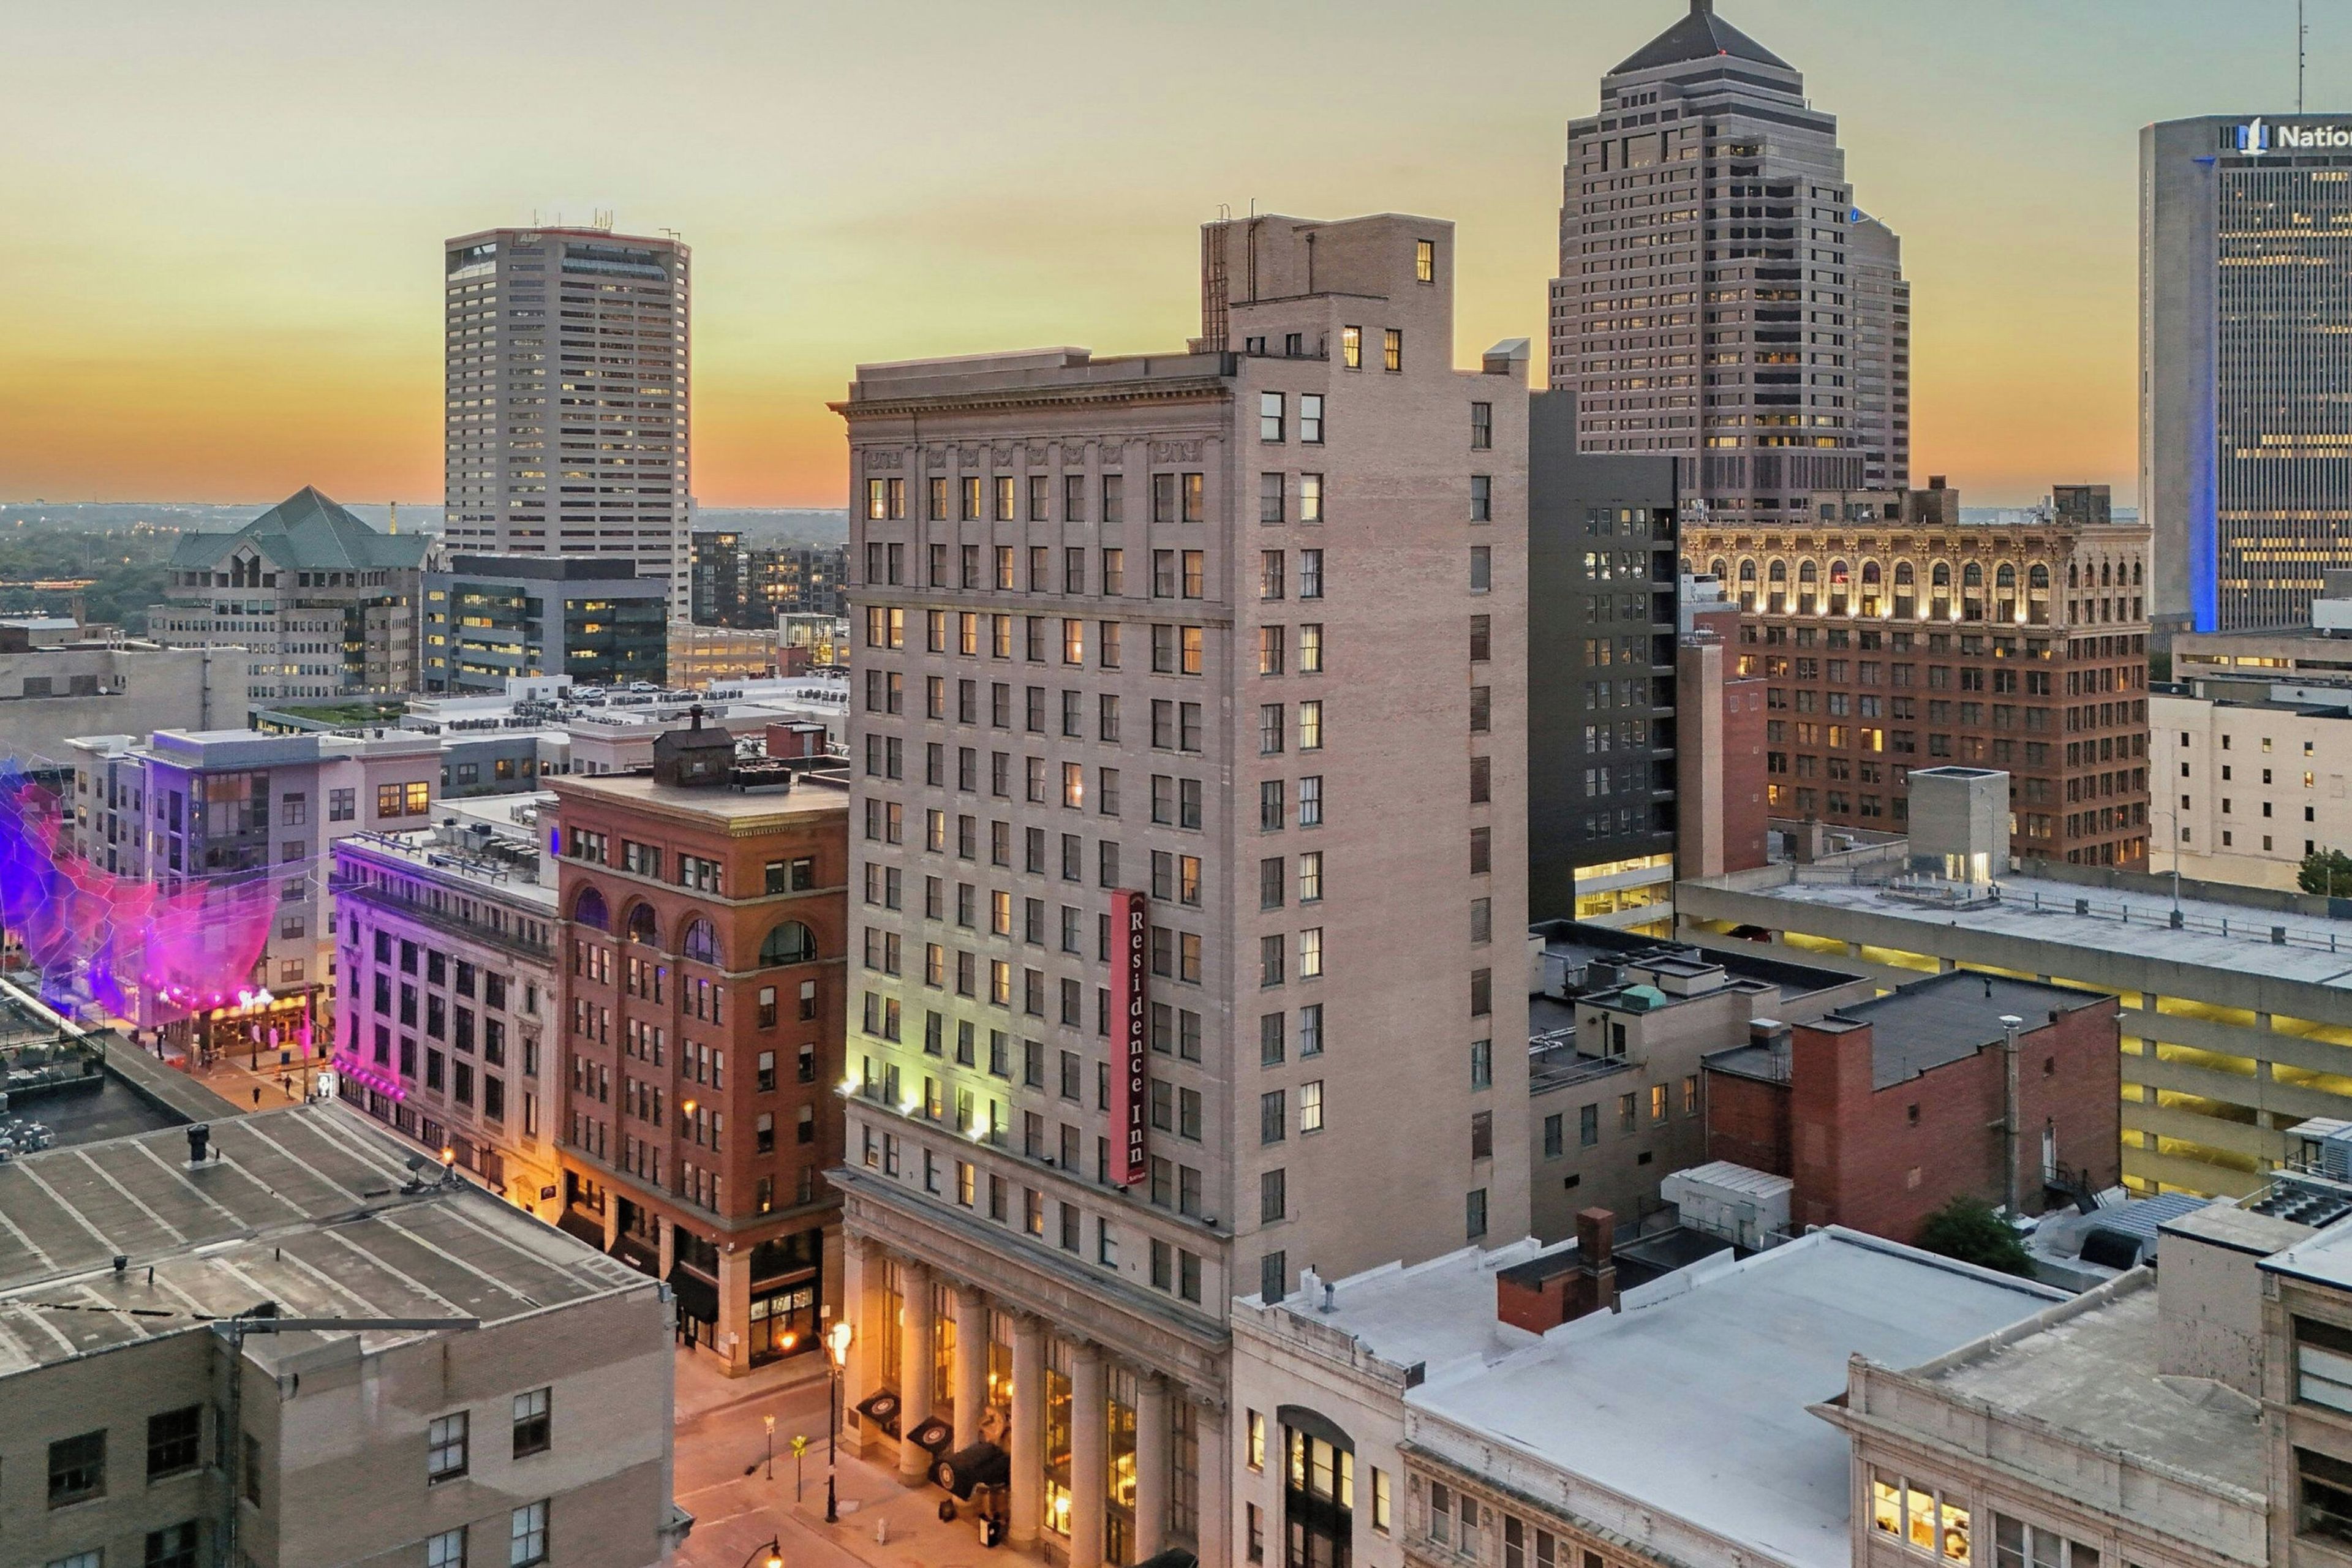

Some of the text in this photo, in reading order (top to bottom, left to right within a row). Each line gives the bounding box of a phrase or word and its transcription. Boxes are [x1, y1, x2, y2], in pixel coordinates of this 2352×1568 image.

[2279, 126, 2352, 147] Natio
[1130, 911, 1144, 1093] Residence
[1130, 1104, 1143, 1163] Inn
